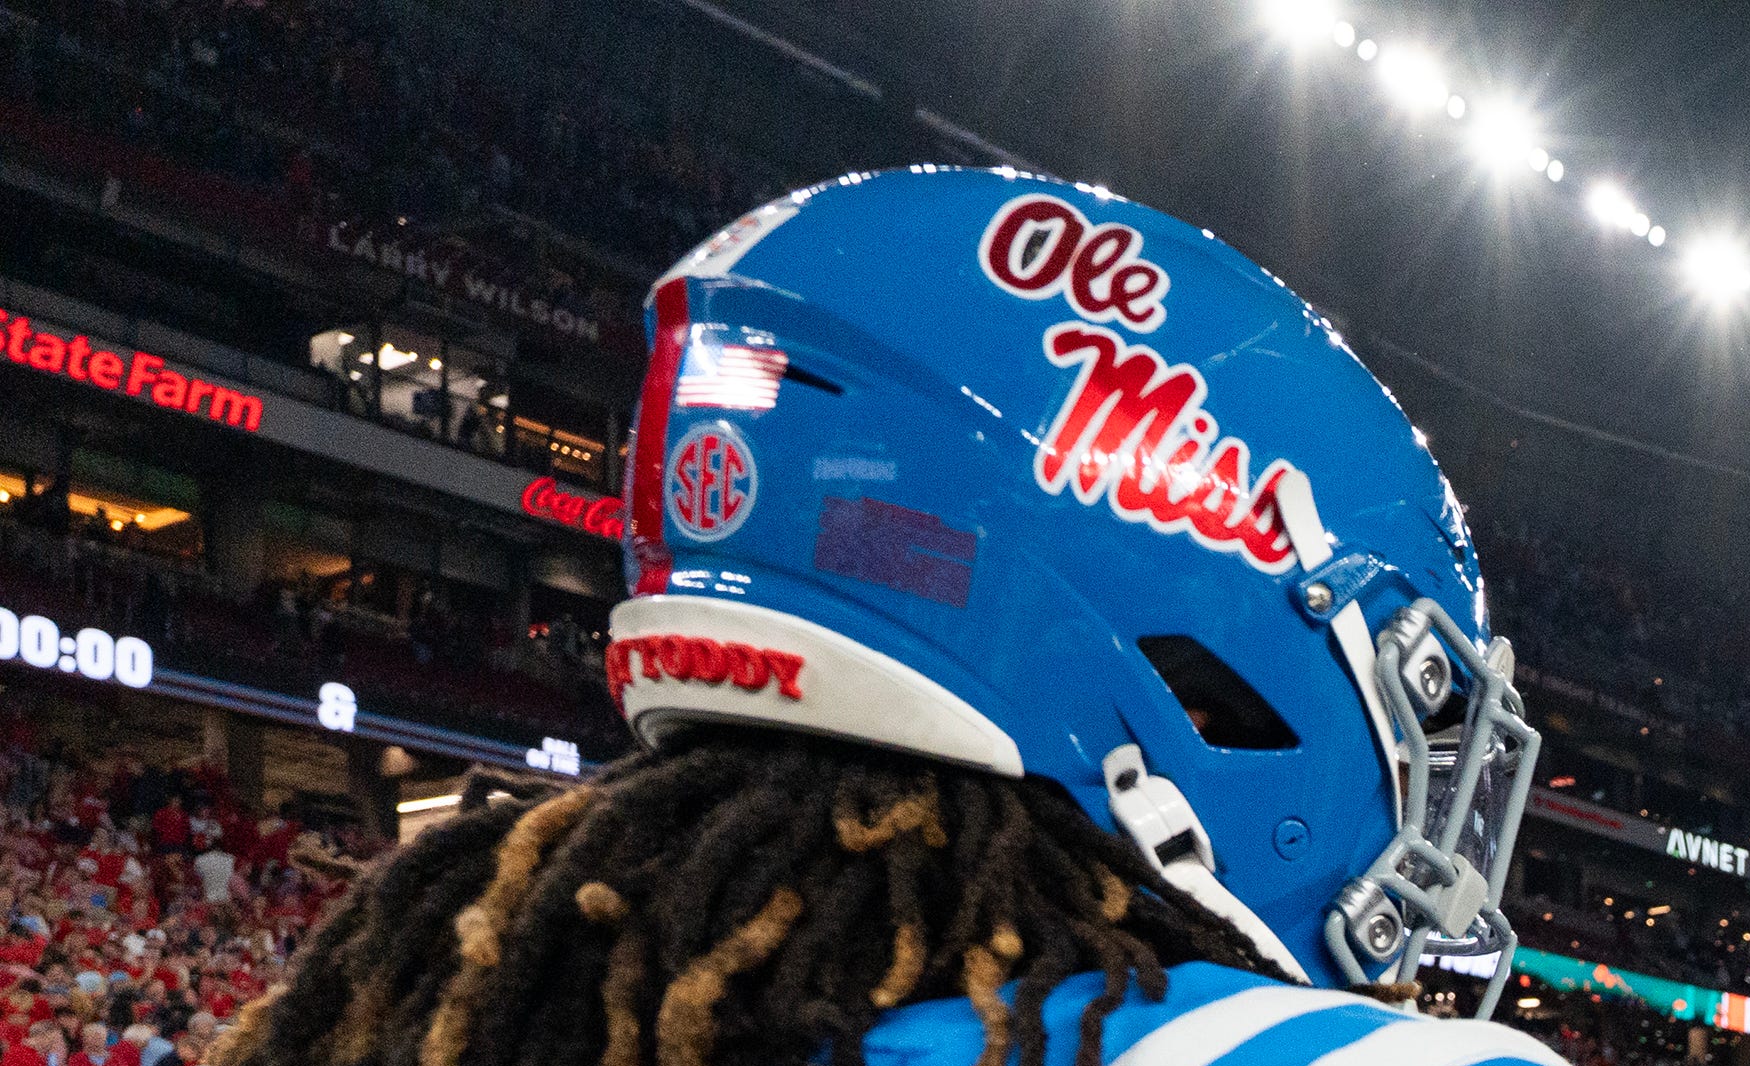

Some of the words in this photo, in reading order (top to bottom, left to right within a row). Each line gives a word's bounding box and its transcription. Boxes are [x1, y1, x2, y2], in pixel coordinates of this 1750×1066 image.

[979, 193, 1170, 333] Ole
[675, 433, 747, 530] SEC
[1034, 321, 1302, 575] Miss
[1665, 828, 1749, 877] AVNET
